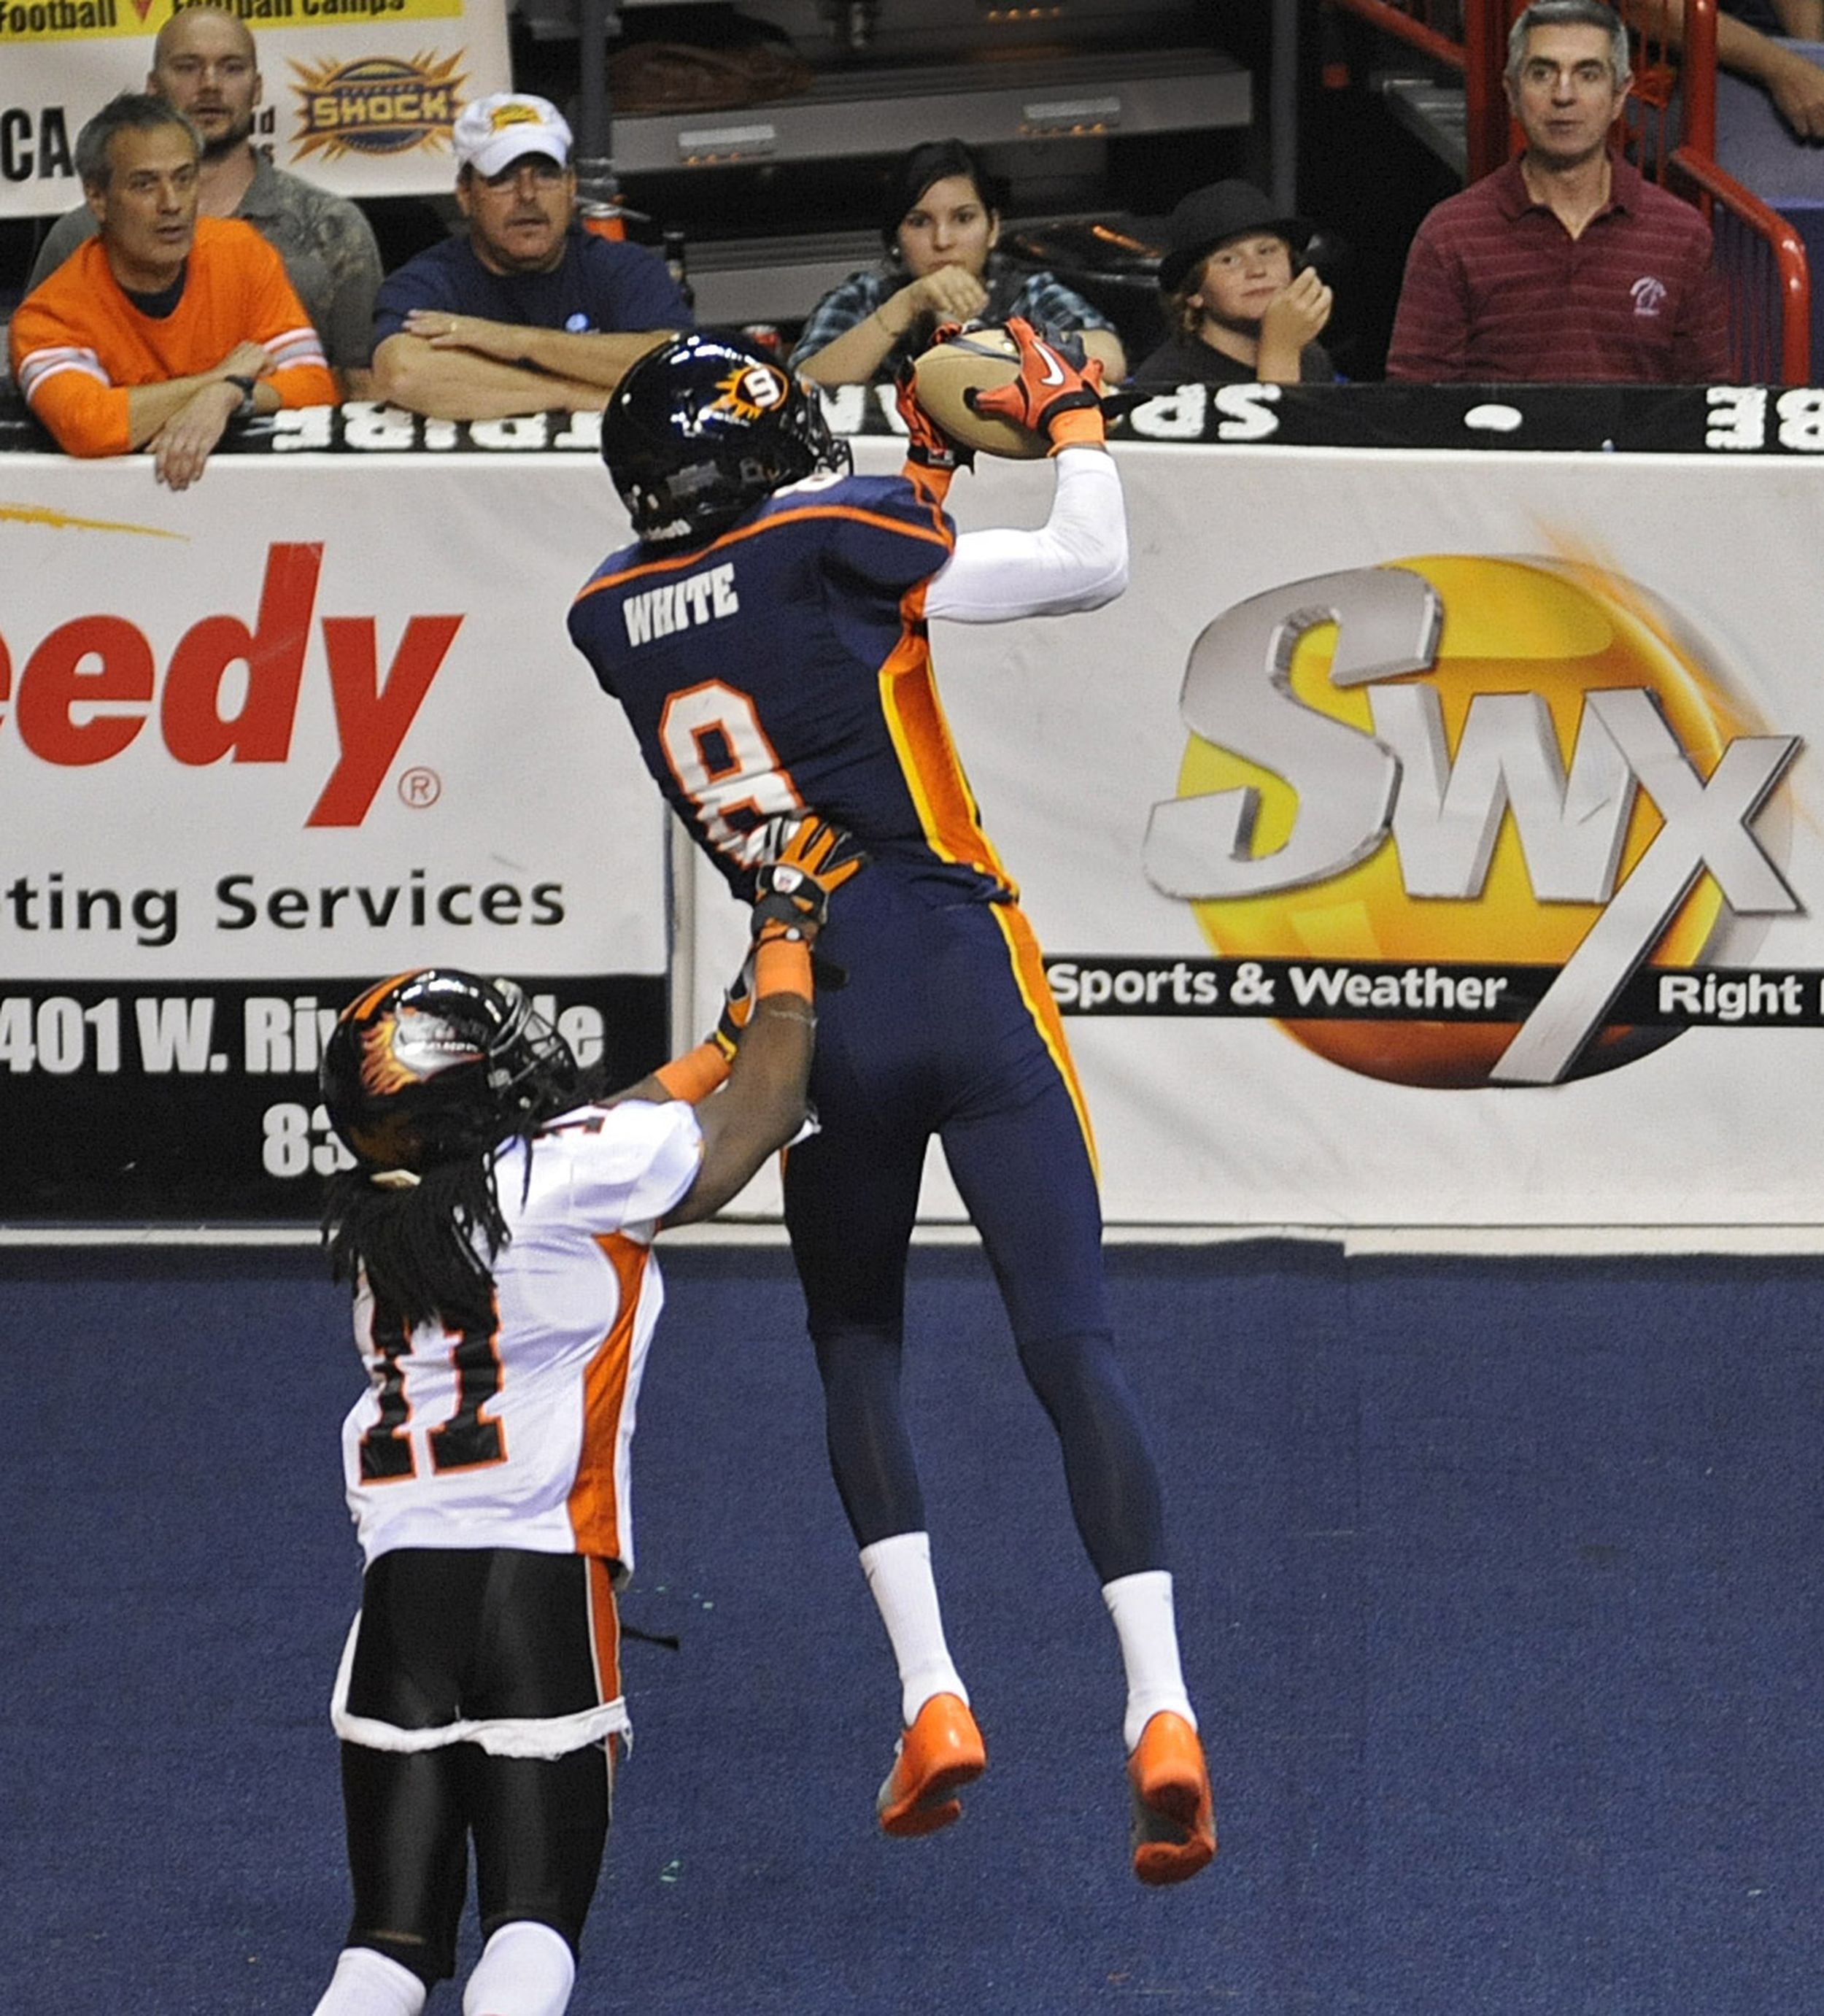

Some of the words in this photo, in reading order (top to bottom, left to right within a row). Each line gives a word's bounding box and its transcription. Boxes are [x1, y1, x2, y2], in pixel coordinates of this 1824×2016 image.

[312, 90, 449, 129] SHOCK
[622, 562, 739, 646] WHITE
[658, 677, 808, 871] 8
[6, 873, 178, 947] ting
[215, 869, 565, 930] Services
[1046, 962, 1218, 1008] Sports
[1230, 962, 1275, 1005] &
[1288, 967, 1507, 1009] Weather
[1658, 973, 1804, 1021] Right
[135, 997, 228, 1073] W.
